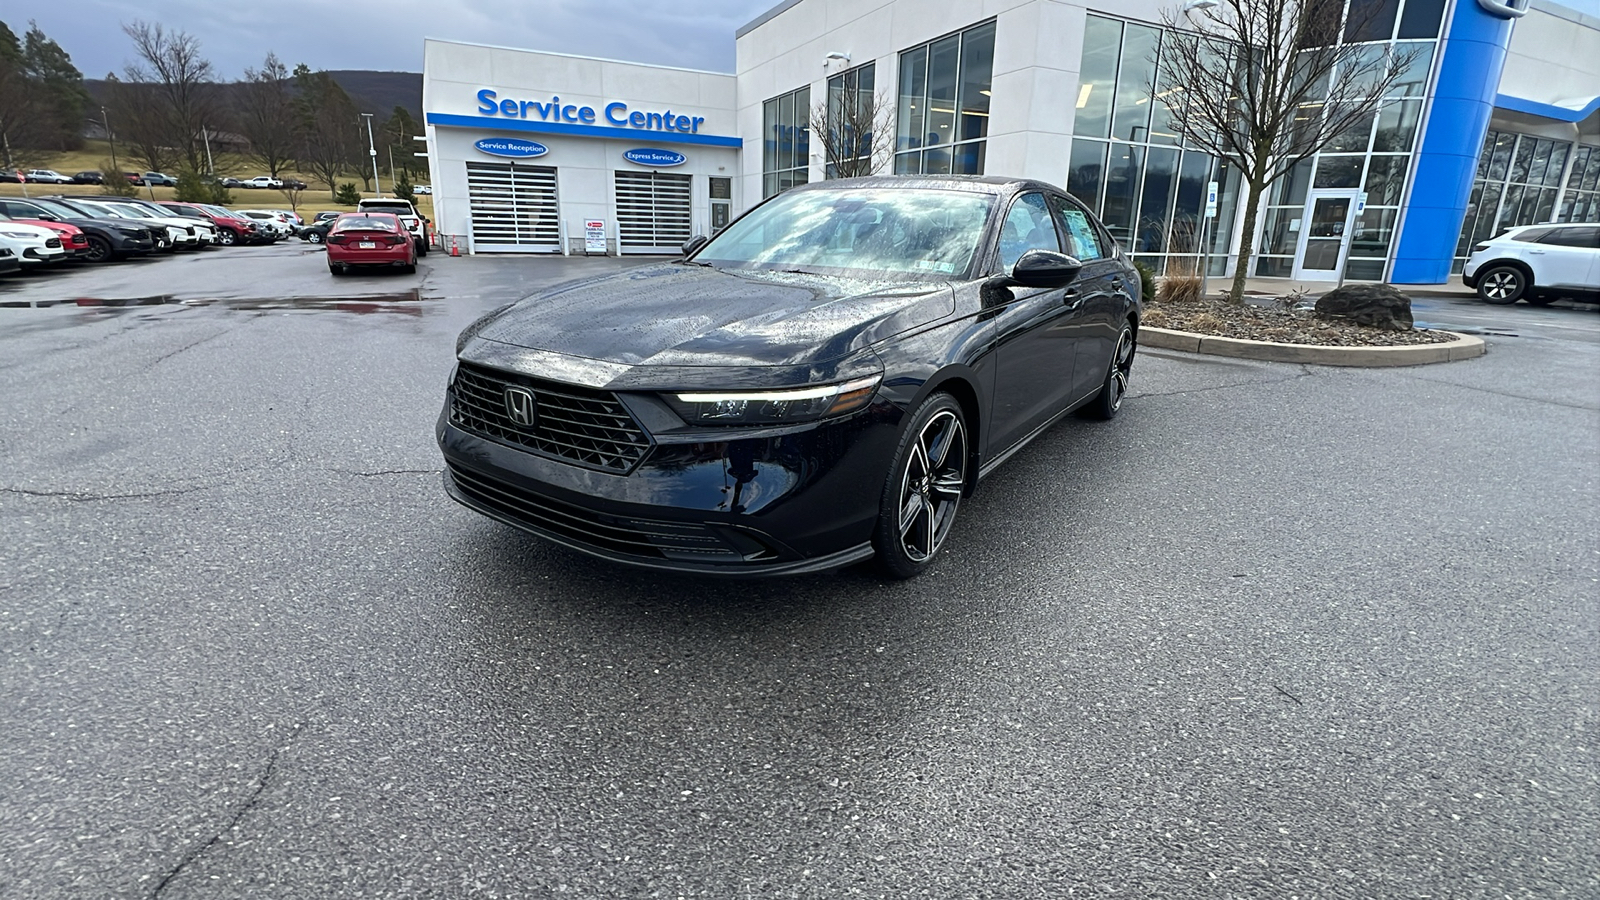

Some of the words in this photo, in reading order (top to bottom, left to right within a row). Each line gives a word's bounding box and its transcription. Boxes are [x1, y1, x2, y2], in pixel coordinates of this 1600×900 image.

[477, 89, 596, 124] Service
[604, 102, 705, 134] Center
[479, 141, 507, 150] Service
[508, 143, 544, 153] Reception
[627, 152, 650, 160] Express
[651, 153, 674, 161] Service
